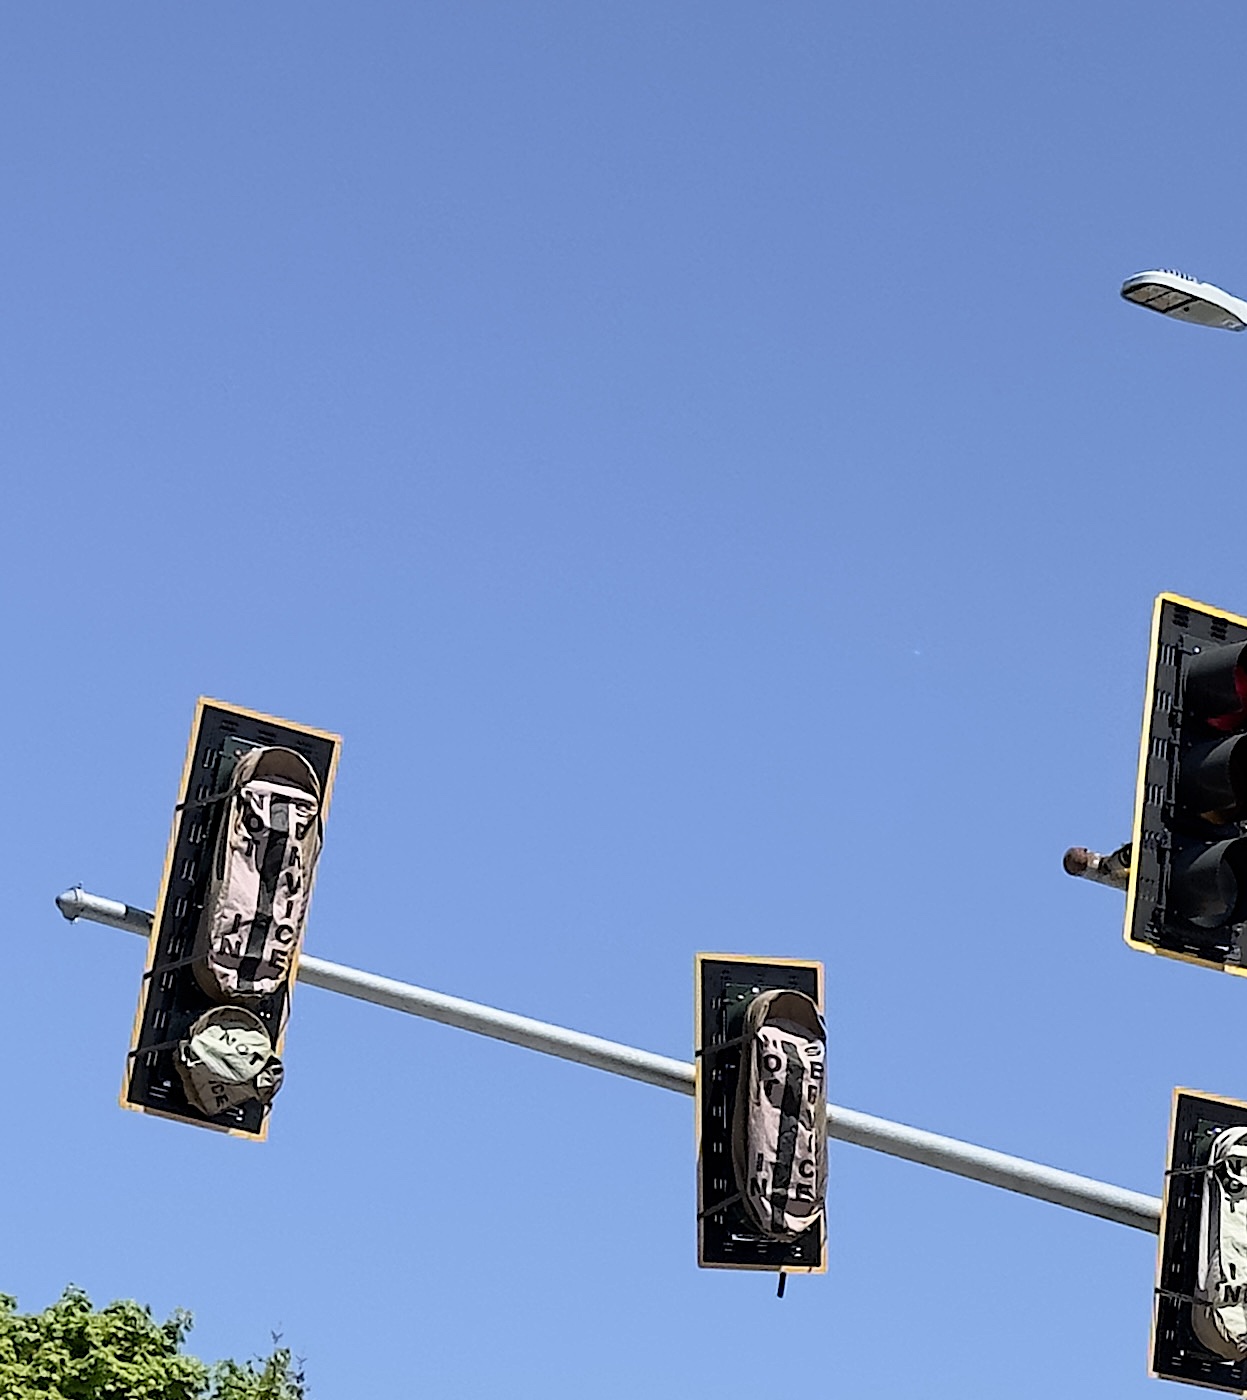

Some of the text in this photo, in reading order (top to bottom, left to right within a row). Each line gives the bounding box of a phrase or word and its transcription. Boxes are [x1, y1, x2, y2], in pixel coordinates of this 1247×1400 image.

[218, 1030, 265, 1067] NOT
[750, 1152, 768, 1197] IN
[1222, 1158, 1245, 1303] NOT IN
